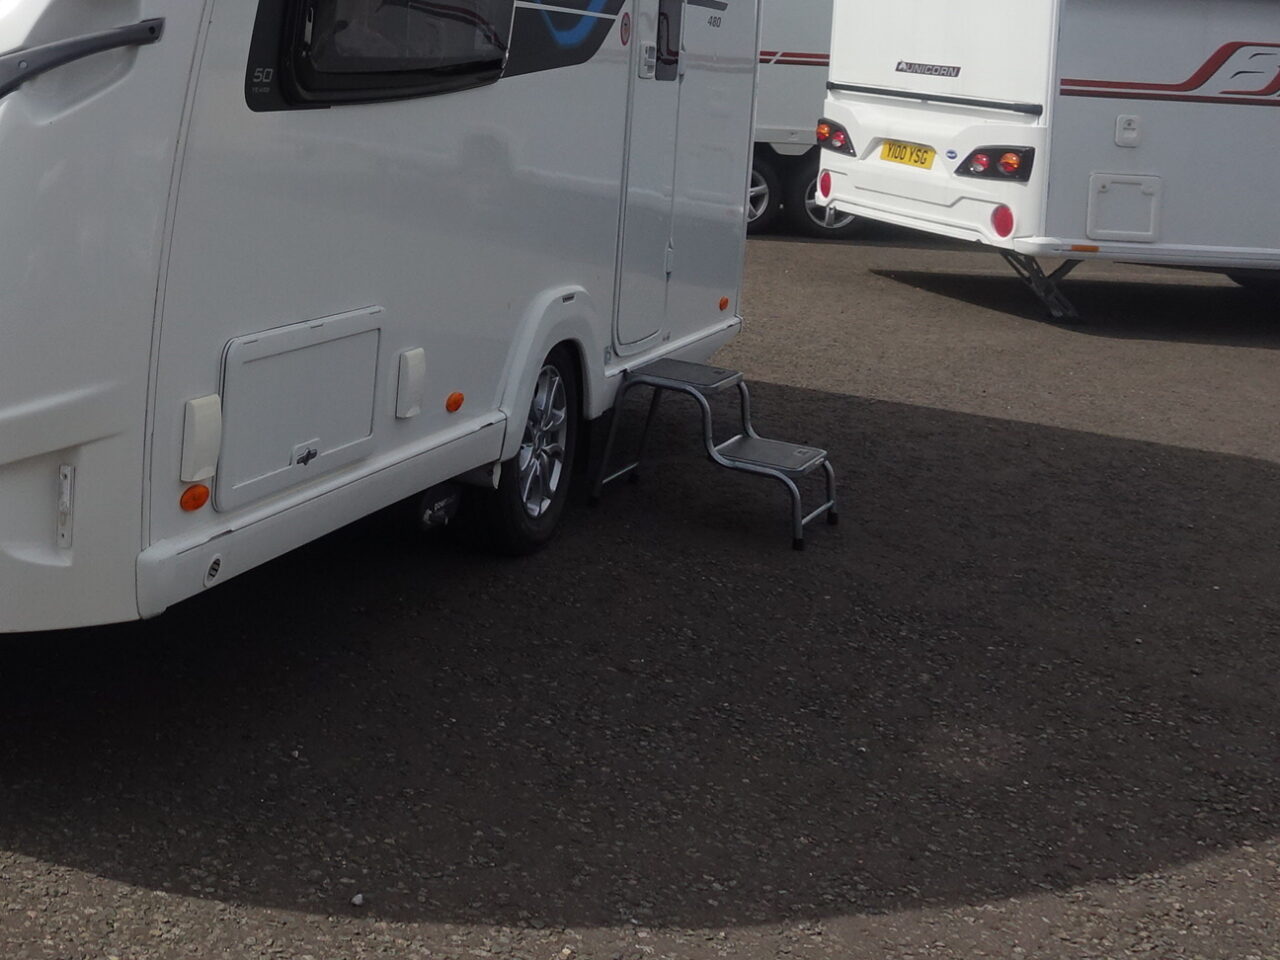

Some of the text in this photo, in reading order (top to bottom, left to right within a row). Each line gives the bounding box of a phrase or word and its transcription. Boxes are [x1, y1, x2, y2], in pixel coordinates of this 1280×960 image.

[253, 68, 273, 82] 50
[906, 63, 958, 77] UNICORN
[909, 146, 929, 165] YSG
